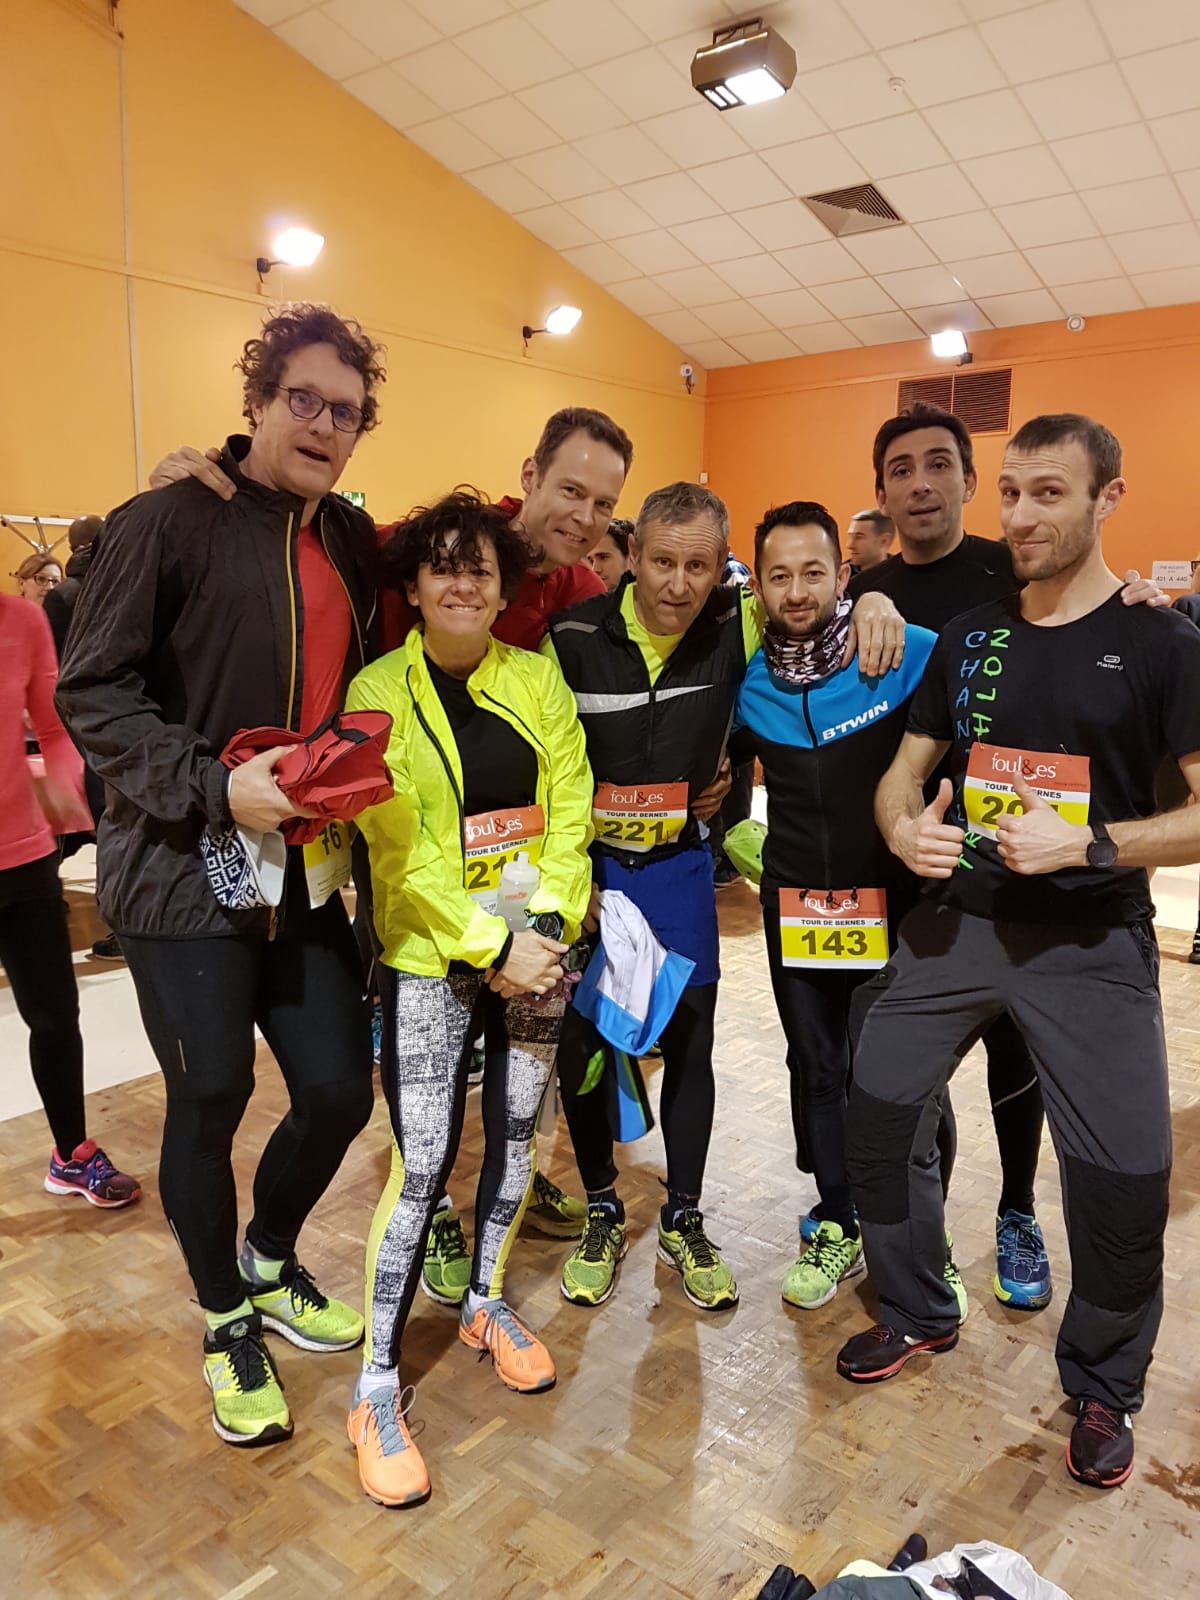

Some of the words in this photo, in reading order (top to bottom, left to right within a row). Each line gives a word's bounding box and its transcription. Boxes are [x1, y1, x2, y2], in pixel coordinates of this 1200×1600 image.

[985, 782, 1009, 792] TOUR
[603, 820, 664, 843] 221
[466, 848, 489, 857] TOUR
[490, 844, 501, 853] DE
[501, 838, 529, 850] BERNES
[467, 850, 530, 890] 21
[801, 929, 869, 956] 143
